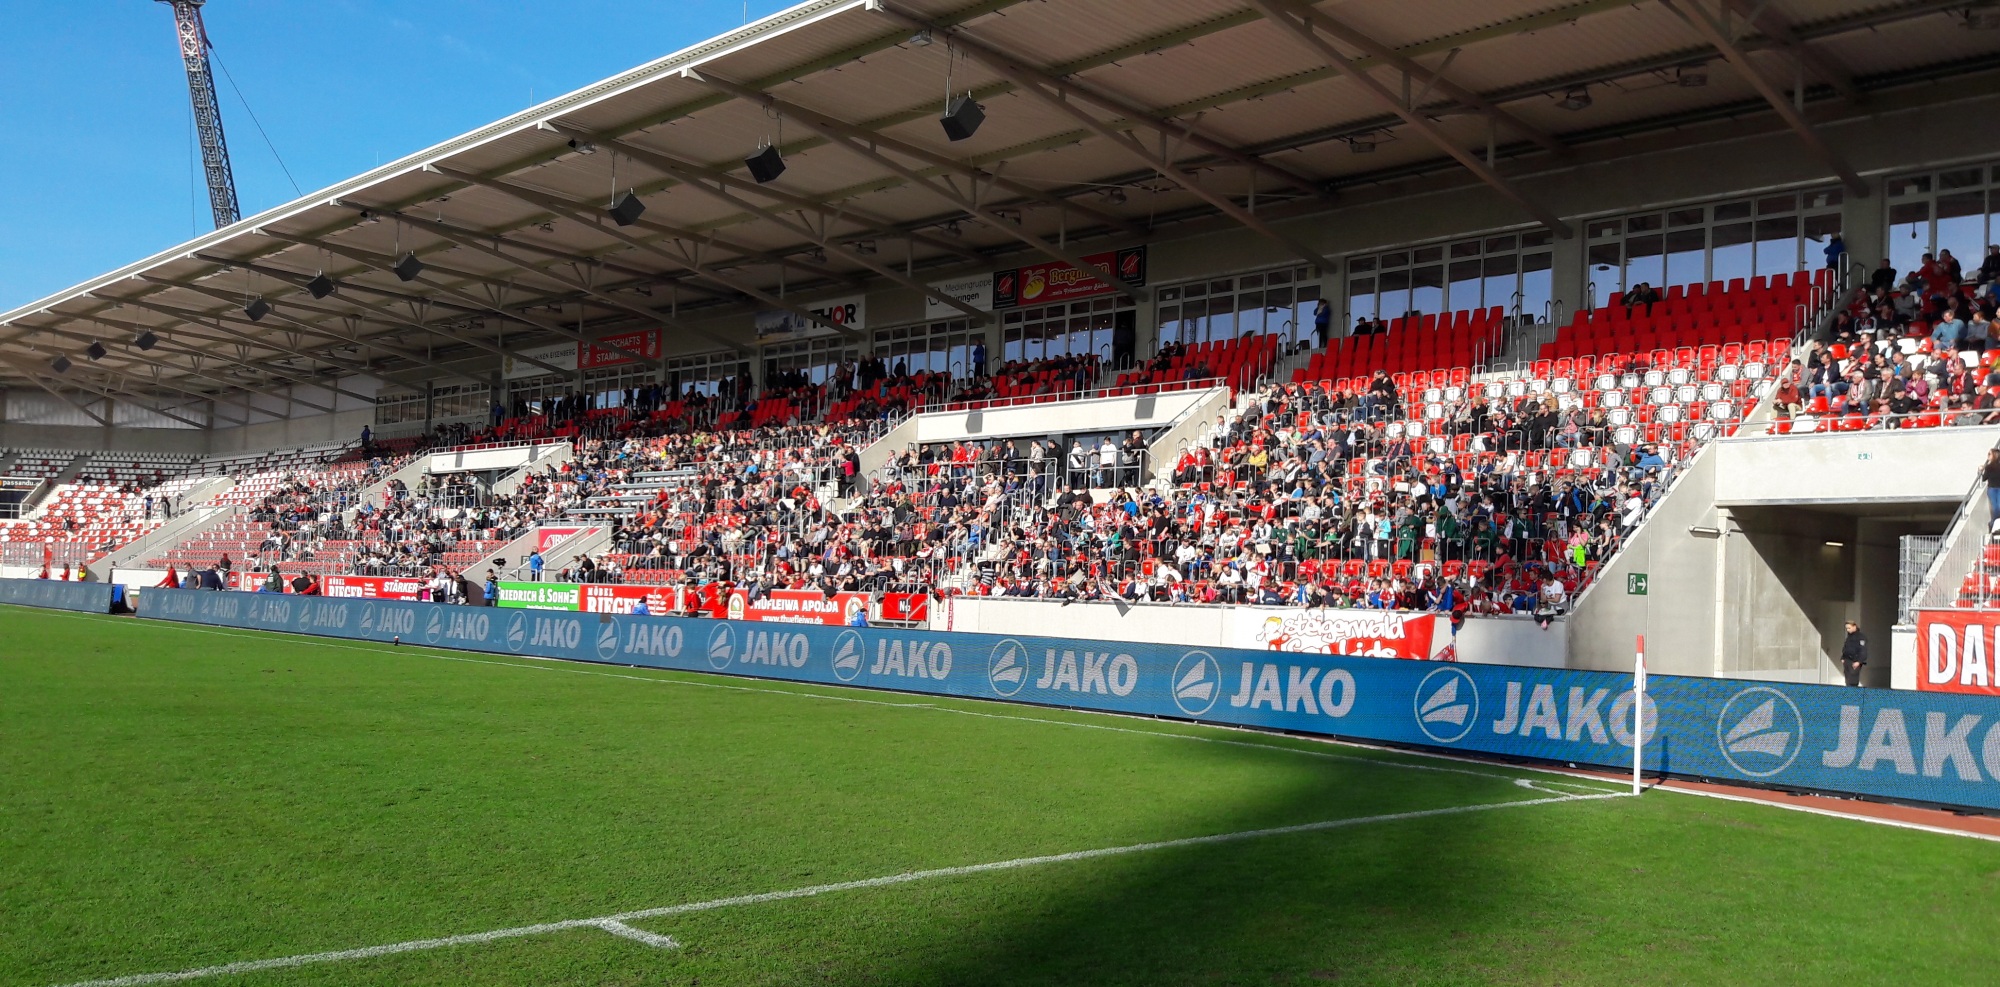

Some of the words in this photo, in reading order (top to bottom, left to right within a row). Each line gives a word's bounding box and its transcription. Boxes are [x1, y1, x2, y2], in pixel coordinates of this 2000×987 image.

[1049, 262, 1109, 286] Bergmn
[948, 292, 980, 303] üringen
[596, 336, 641, 351] TSCHAFTS
[596, 347, 641, 363] STAMMH
[383, 579, 418, 593] STÄRKER
[538, 587, 546, 603] &
[587, 586, 614, 597] MÖBEL
[262, 600, 291, 624] JAKO
[313, 603, 347, 629] JAKO
[378, 606, 415, 634] JAKO
[801, 599, 839, 613] APOLDA
[446, 612, 489, 641] JAKO
[530, 617, 580, 649] JAKO
[624, 623, 683, 658] JAKO
[1283, 613, 1406, 644] steigerwald
[740, 630, 809, 668] JAKO
[870, 639, 953, 680] JAKO
[1928, 622, 2000, 687] DA
[1036, 648, 1138, 697] JAKO
[1230, 661, 1357, 718] JAKO
[1493, 682, 1659, 748] JAKO
